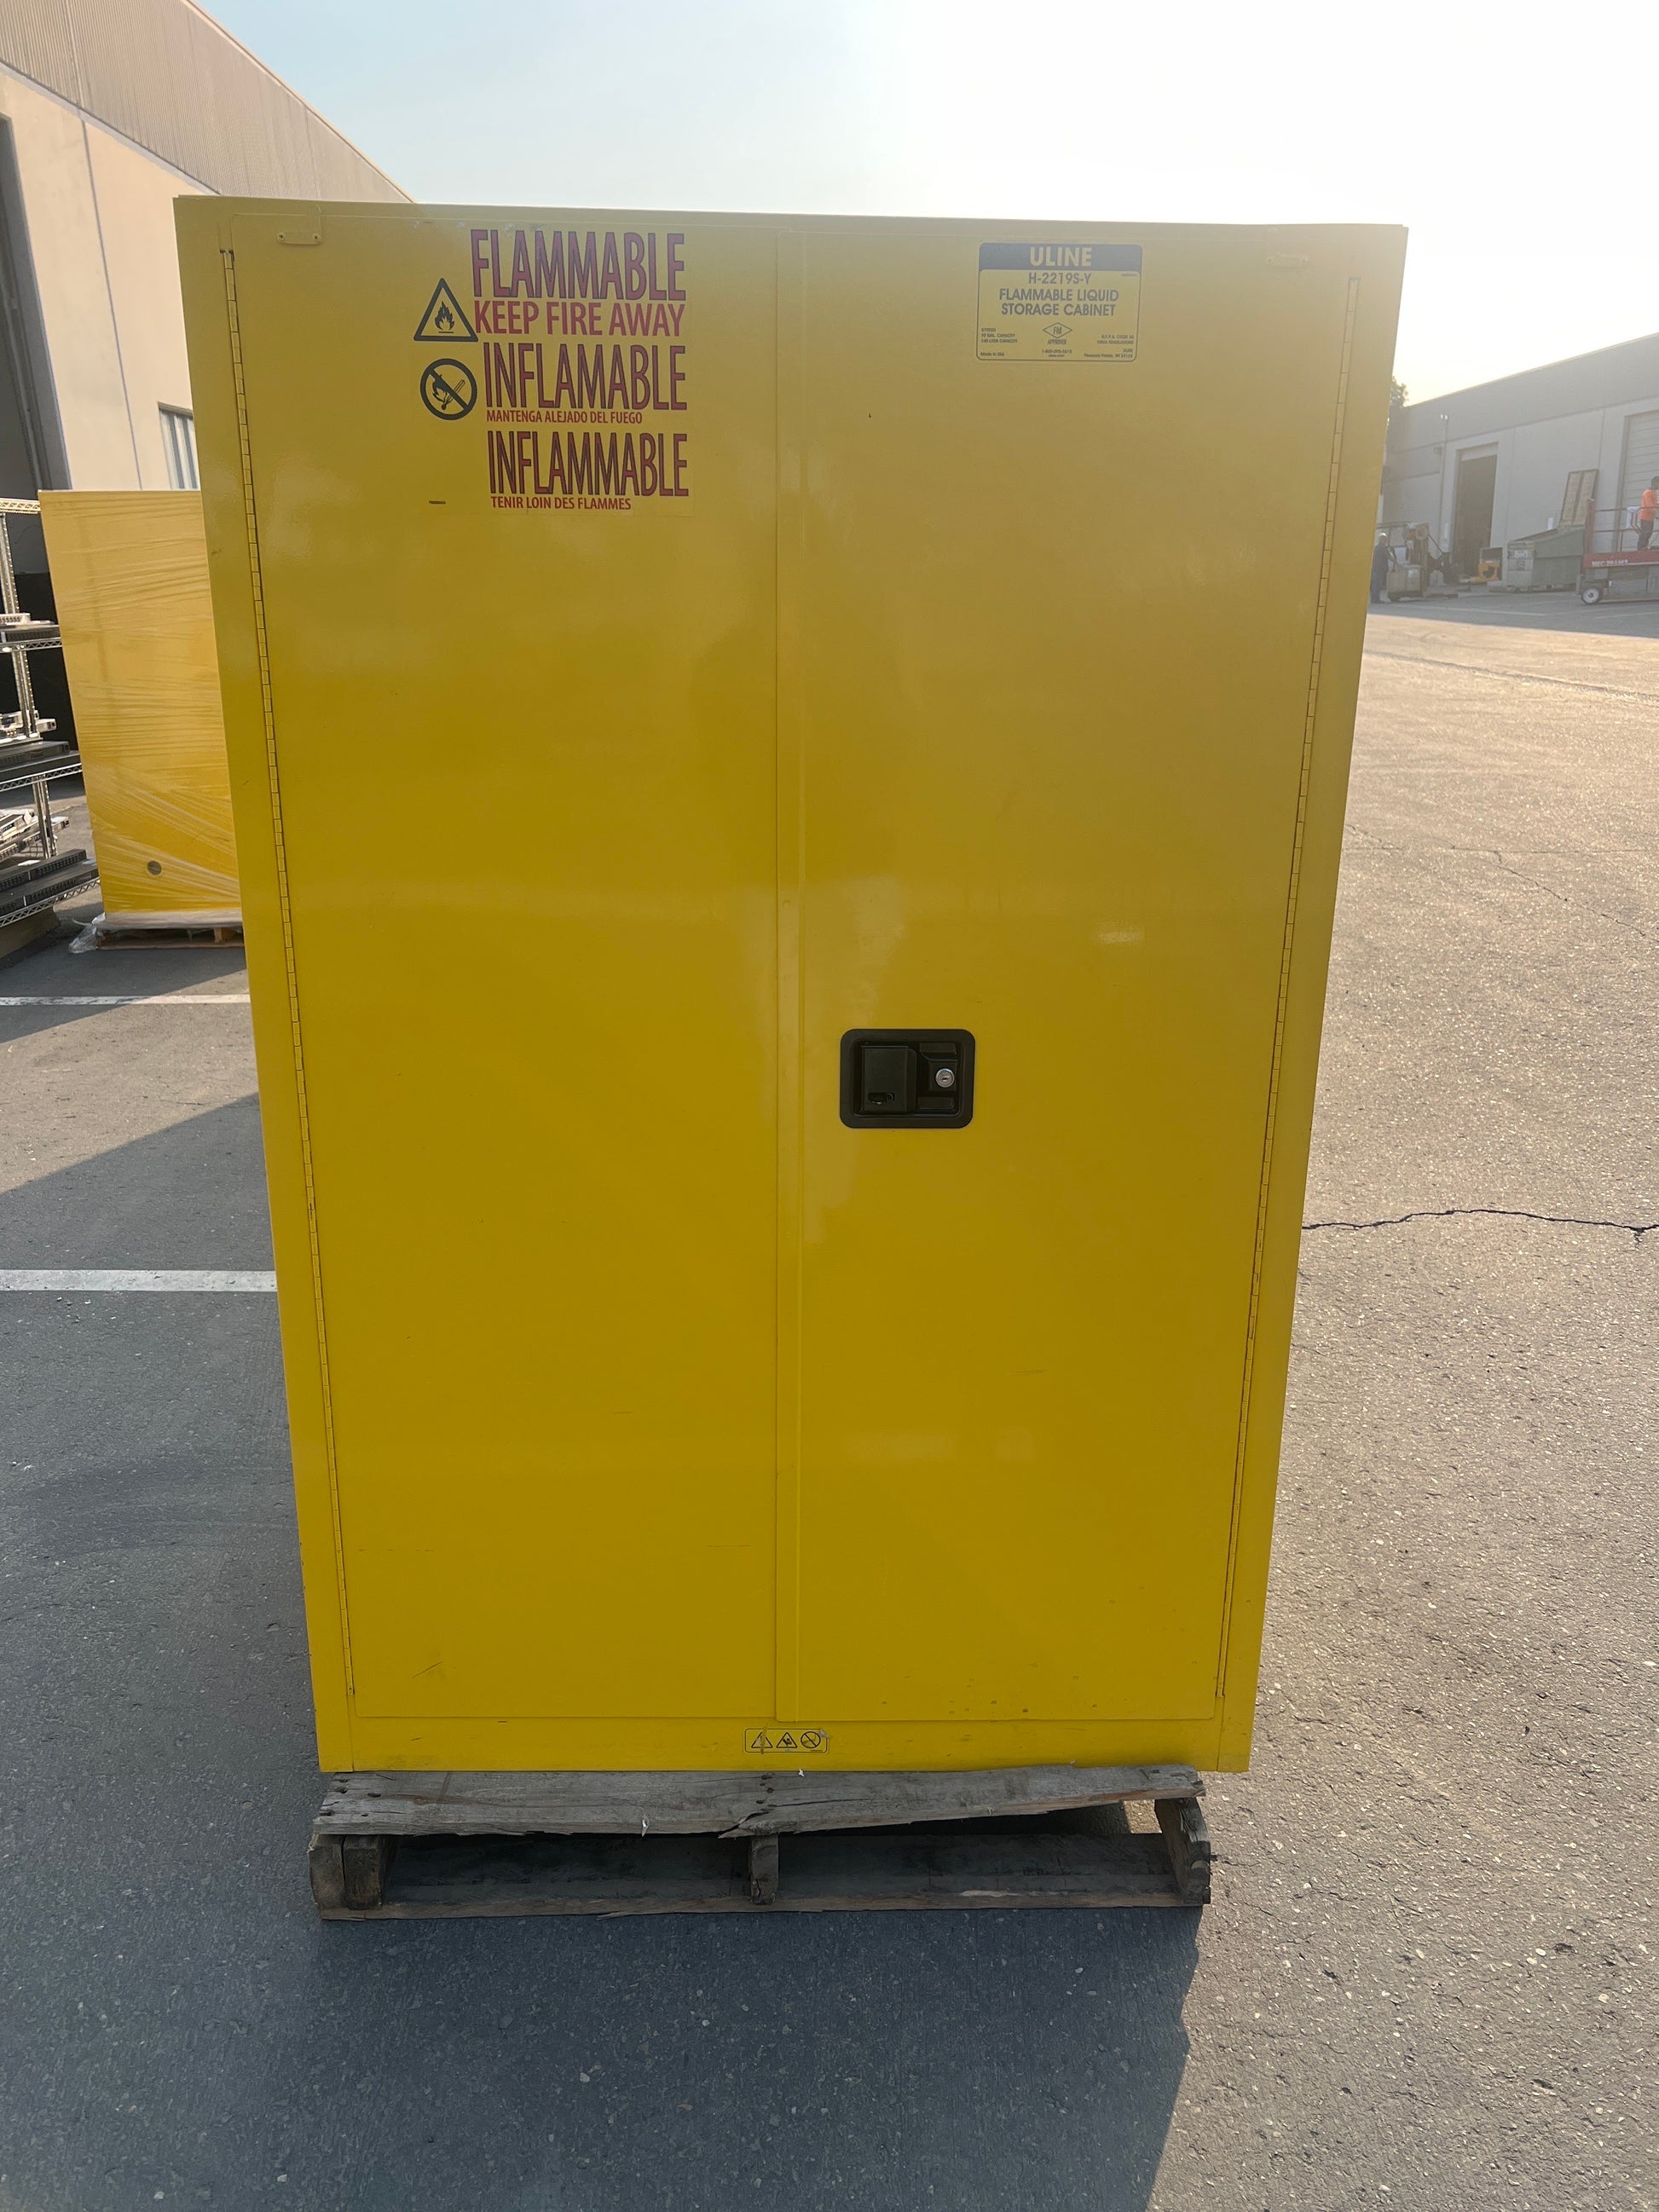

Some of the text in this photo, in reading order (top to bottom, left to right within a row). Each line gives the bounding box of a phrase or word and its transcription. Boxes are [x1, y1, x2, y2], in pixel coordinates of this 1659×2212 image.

[1029, 246, 1092, 267] ULINE
[471, 228, 686, 301] FLAMMABLE
[1028, 272, 1092, 285] H-2219S-Y
[999, 288, 1119, 303] FLAMMABLE LIQUID
[1001, 303, 1117, 316] STORAGE CABINET
[474, 300, 685, 337] KEEP FIRE AWAY
[1053, 326, 1062, 335] FM
[483, 342, 687, 411] INFLAMABLE
[487, 410, 643, 424] MANTENGA ALEJADO DEL FUEGO
[487, 430, 689, 497] INFLAMMABLE
[491, 496, 632, 510] TENIR LOIN DES FLAMMES
